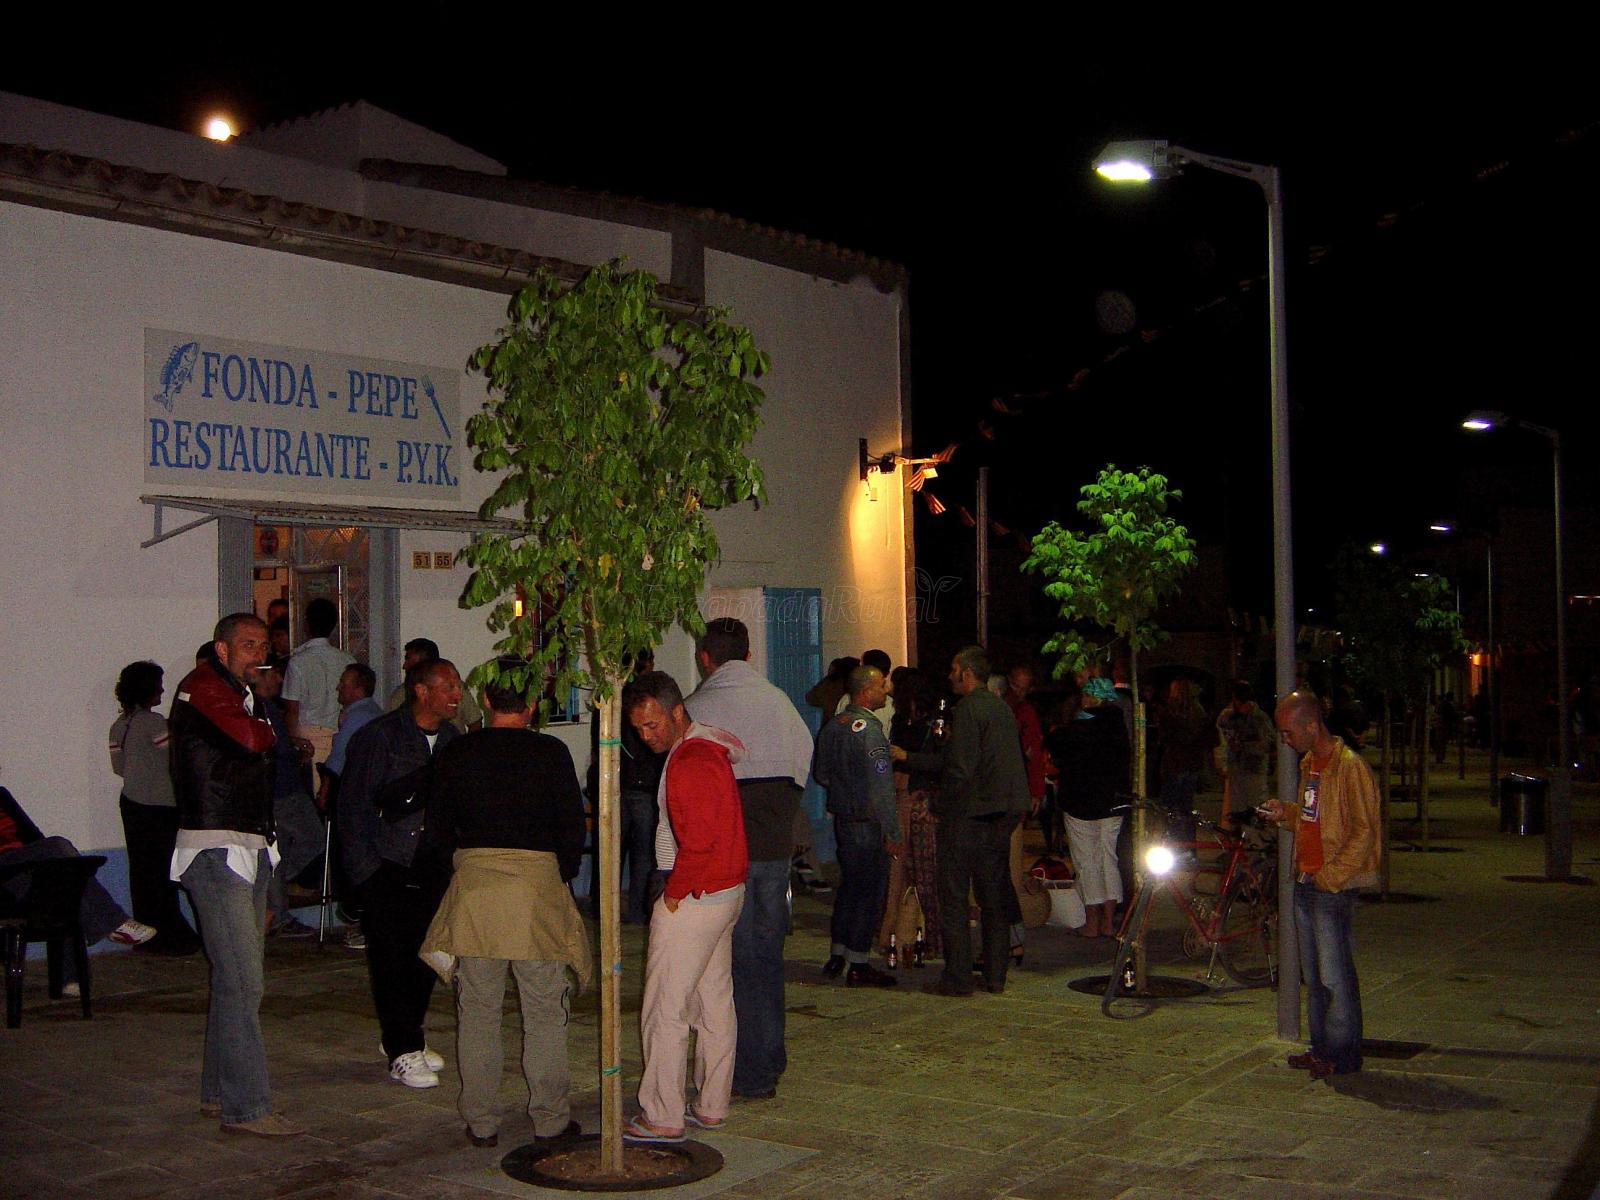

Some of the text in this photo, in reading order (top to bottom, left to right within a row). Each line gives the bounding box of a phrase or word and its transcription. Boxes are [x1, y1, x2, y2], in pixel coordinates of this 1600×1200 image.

[201, 351, 319, 409] FONDA
[347, 368, 419, 420] PEPE
[149, 417, 371, 481] RESTAURANTE
